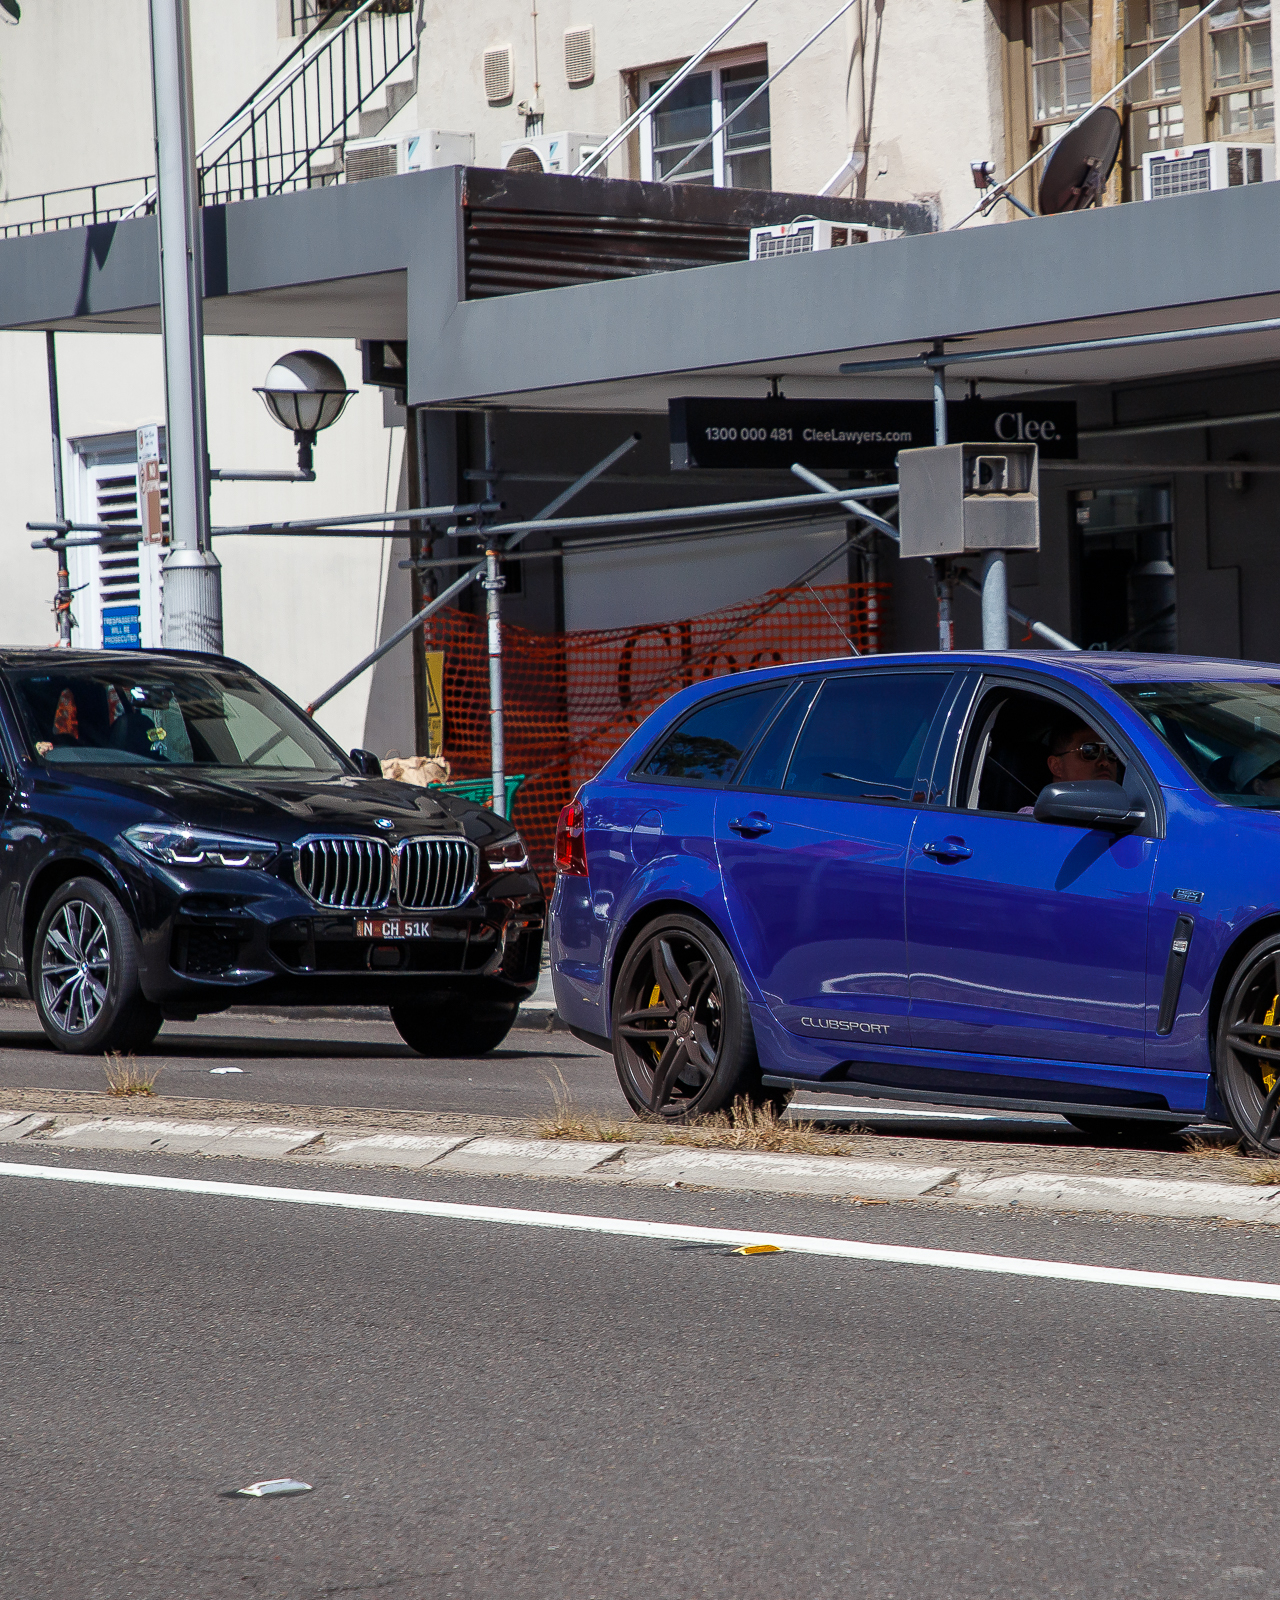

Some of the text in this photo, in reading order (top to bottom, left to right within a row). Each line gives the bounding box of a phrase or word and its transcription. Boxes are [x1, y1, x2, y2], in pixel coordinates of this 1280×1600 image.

[994, 412, 1061, 440] Clee.
[705, 428, 912, 444] 1300 000 481 CleeLawyers.com
[364, 922, 373, 936] N
[382, 922, 399, 936] CH
[405, 922, 430, 937] 51K
[801, 1017, 890, 1034] CLUBSPORT
